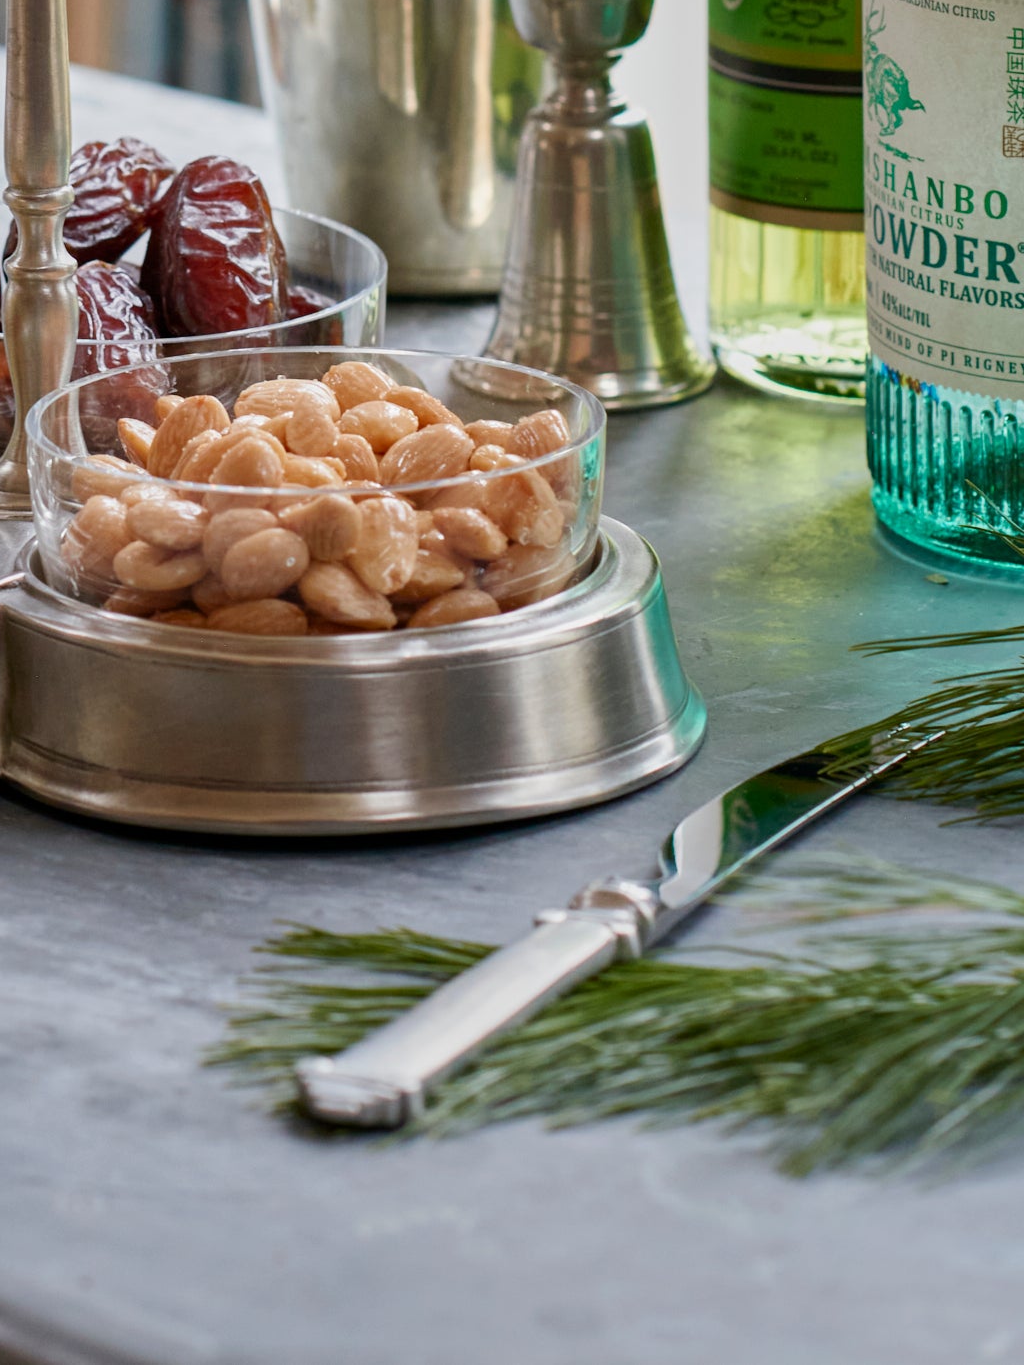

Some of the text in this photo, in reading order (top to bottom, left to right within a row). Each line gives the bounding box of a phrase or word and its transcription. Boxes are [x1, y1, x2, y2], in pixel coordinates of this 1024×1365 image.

[952, 4, 996, 22] CITRUS
[866, 146, 1008, 220] SHANBO
[910, 204, 965, 231] CITRUS
[878, 253, 935, 295] NATURAL
[939, 278, 1024, 310] FLAVORS
[917, 341, 933, 359] OF
[941, 348, 955, 367] PJ
